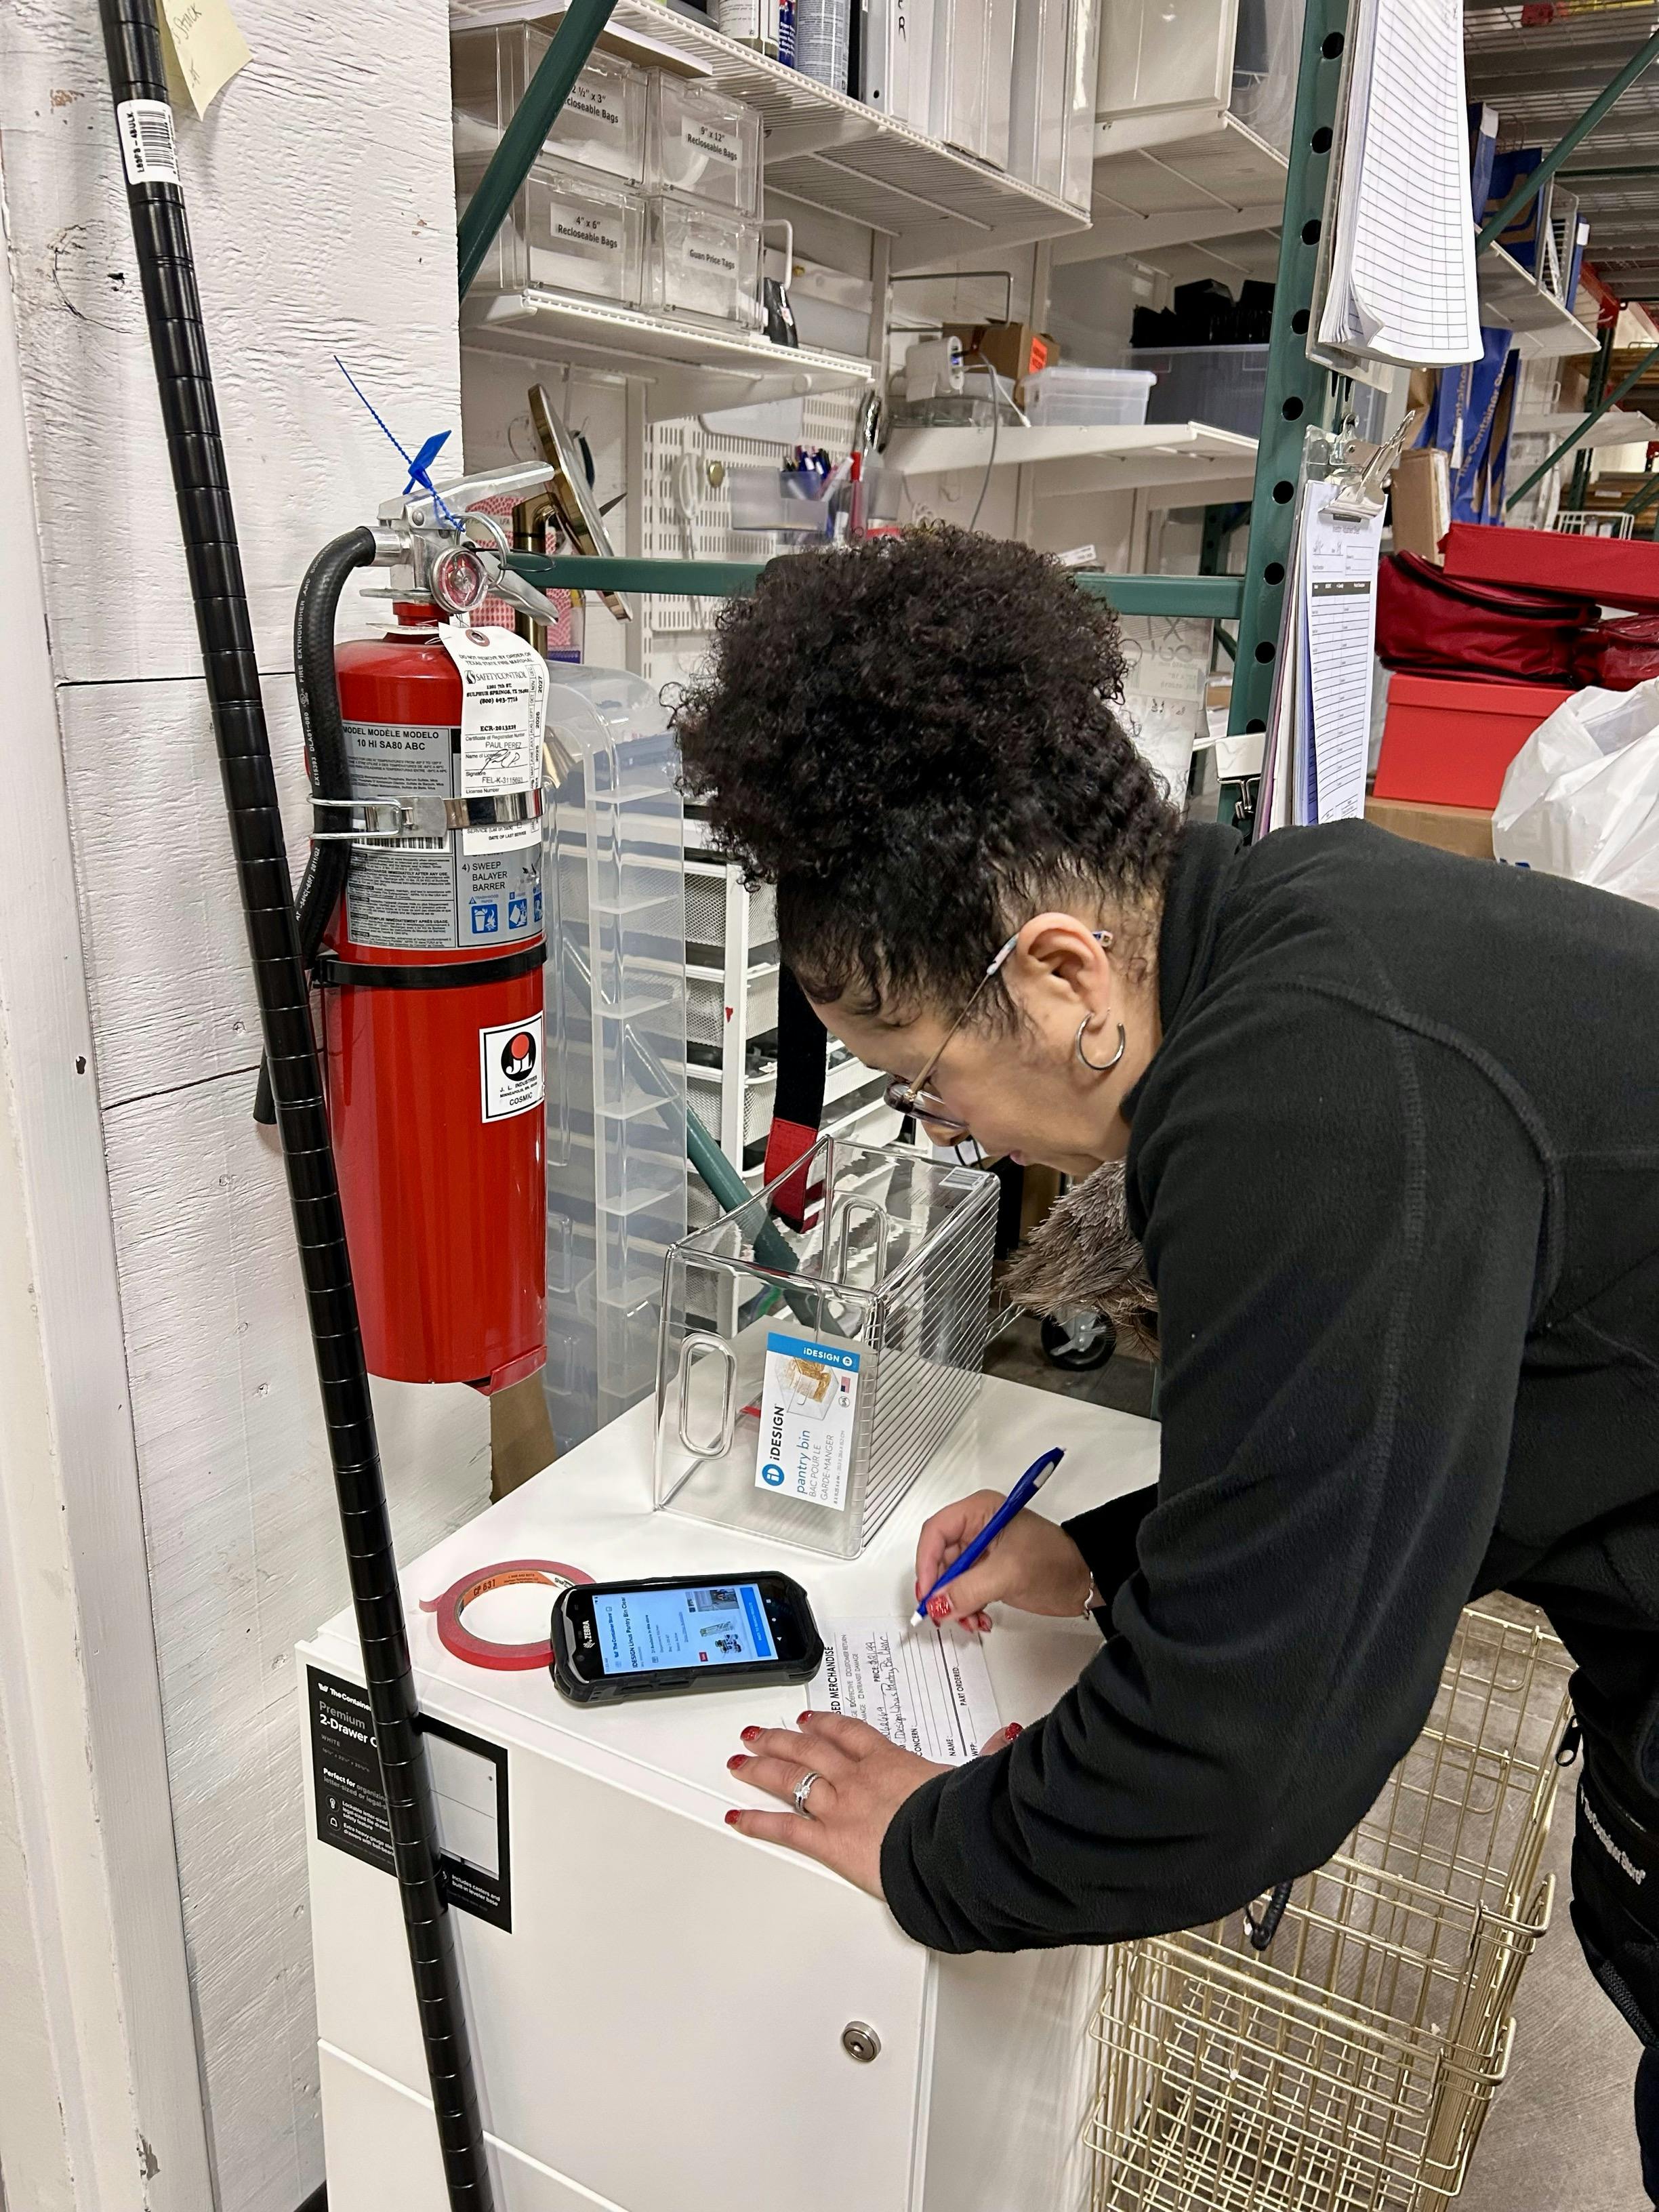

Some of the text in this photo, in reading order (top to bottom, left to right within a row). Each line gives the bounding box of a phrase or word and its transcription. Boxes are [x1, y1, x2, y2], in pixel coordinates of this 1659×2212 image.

[565, 96, 619, 124] closeable Bags
[687, 134, 738, 161] Recloseable Bags
[558, 224, 618, 249] Recloseable Bags
[706, 253, 721, 266] Price
[722, 258, 736, 270] Tags
[1468, 389, 1500, 453] Container
[297, 600, 305, 660] EXTINGUISHER
[302, 577, 311, 597] AND
[476, 670, 527, 682] SAFETYCONTROL
[342, 726, 439, 739] MODEL MODÈLE MODELO
[357, 739, 426, 751] 10 HI SA80 ABC
[462, 861, 501, 873] 4) SWEEP
[472, 871, 508, 881] BALAYER
[472, 882, 506, 892] BARRER
[515, 1075, 537, 1088] INDUSTRIES
[509, 1092, 533, 1106] COSMIC
[803, 1347, 840, 1363] iDESIGN
[769, 1406, 785, 1461] iDESIGN
[813, 1444, 821, 1455] LE
[796, 1430, 811, 1494] pantry bin
[811, 1456, 819, 1479] POUR
[820, 1435, 835, 1500] GARDE-MANGER
[473, 1579, 496, 1596] CP 631
[582, 1620, 592, 1639] ZEBRA
[624, 1618, 632, 1634] Pantry
[843, 1652, 853, 1673] CUSTOMER
[880, 1658, 893, 1673] Bin
[824, 1646, 840, 1698] MERCHANDISE
[852, 1653, 864, 1694] INTRANSIT DAMAGE
[881, 1668, 900, 1696] Pantry
[330, 1687, 342, 1698] The
[956, 1692, 967, 1706] PART
[319, 1700, 365, 1729] Premium
[319, 1713, 369, 1744] 2-Drawer
[321, 1734, 340, 1747] WHITE
[323, 1767, 356, 1788] Perfect for
[324, 1776, 357, 1797] letter-sized
[342, 1801, 363, 1814] Lockable
[342, 1807, 367, 1822] legal-sized
[343, 1812, 373, 1830] safety feature
[451, 1874, 472, 1888] Includes
[472, 1885, 490, 1897] casters
[490, 1893, 501, 1902] and
[452, 1880, 469, 1892] built-in
[468, 1888, 486, 1900] leveler
[486, 1896, 499, 1906] base
